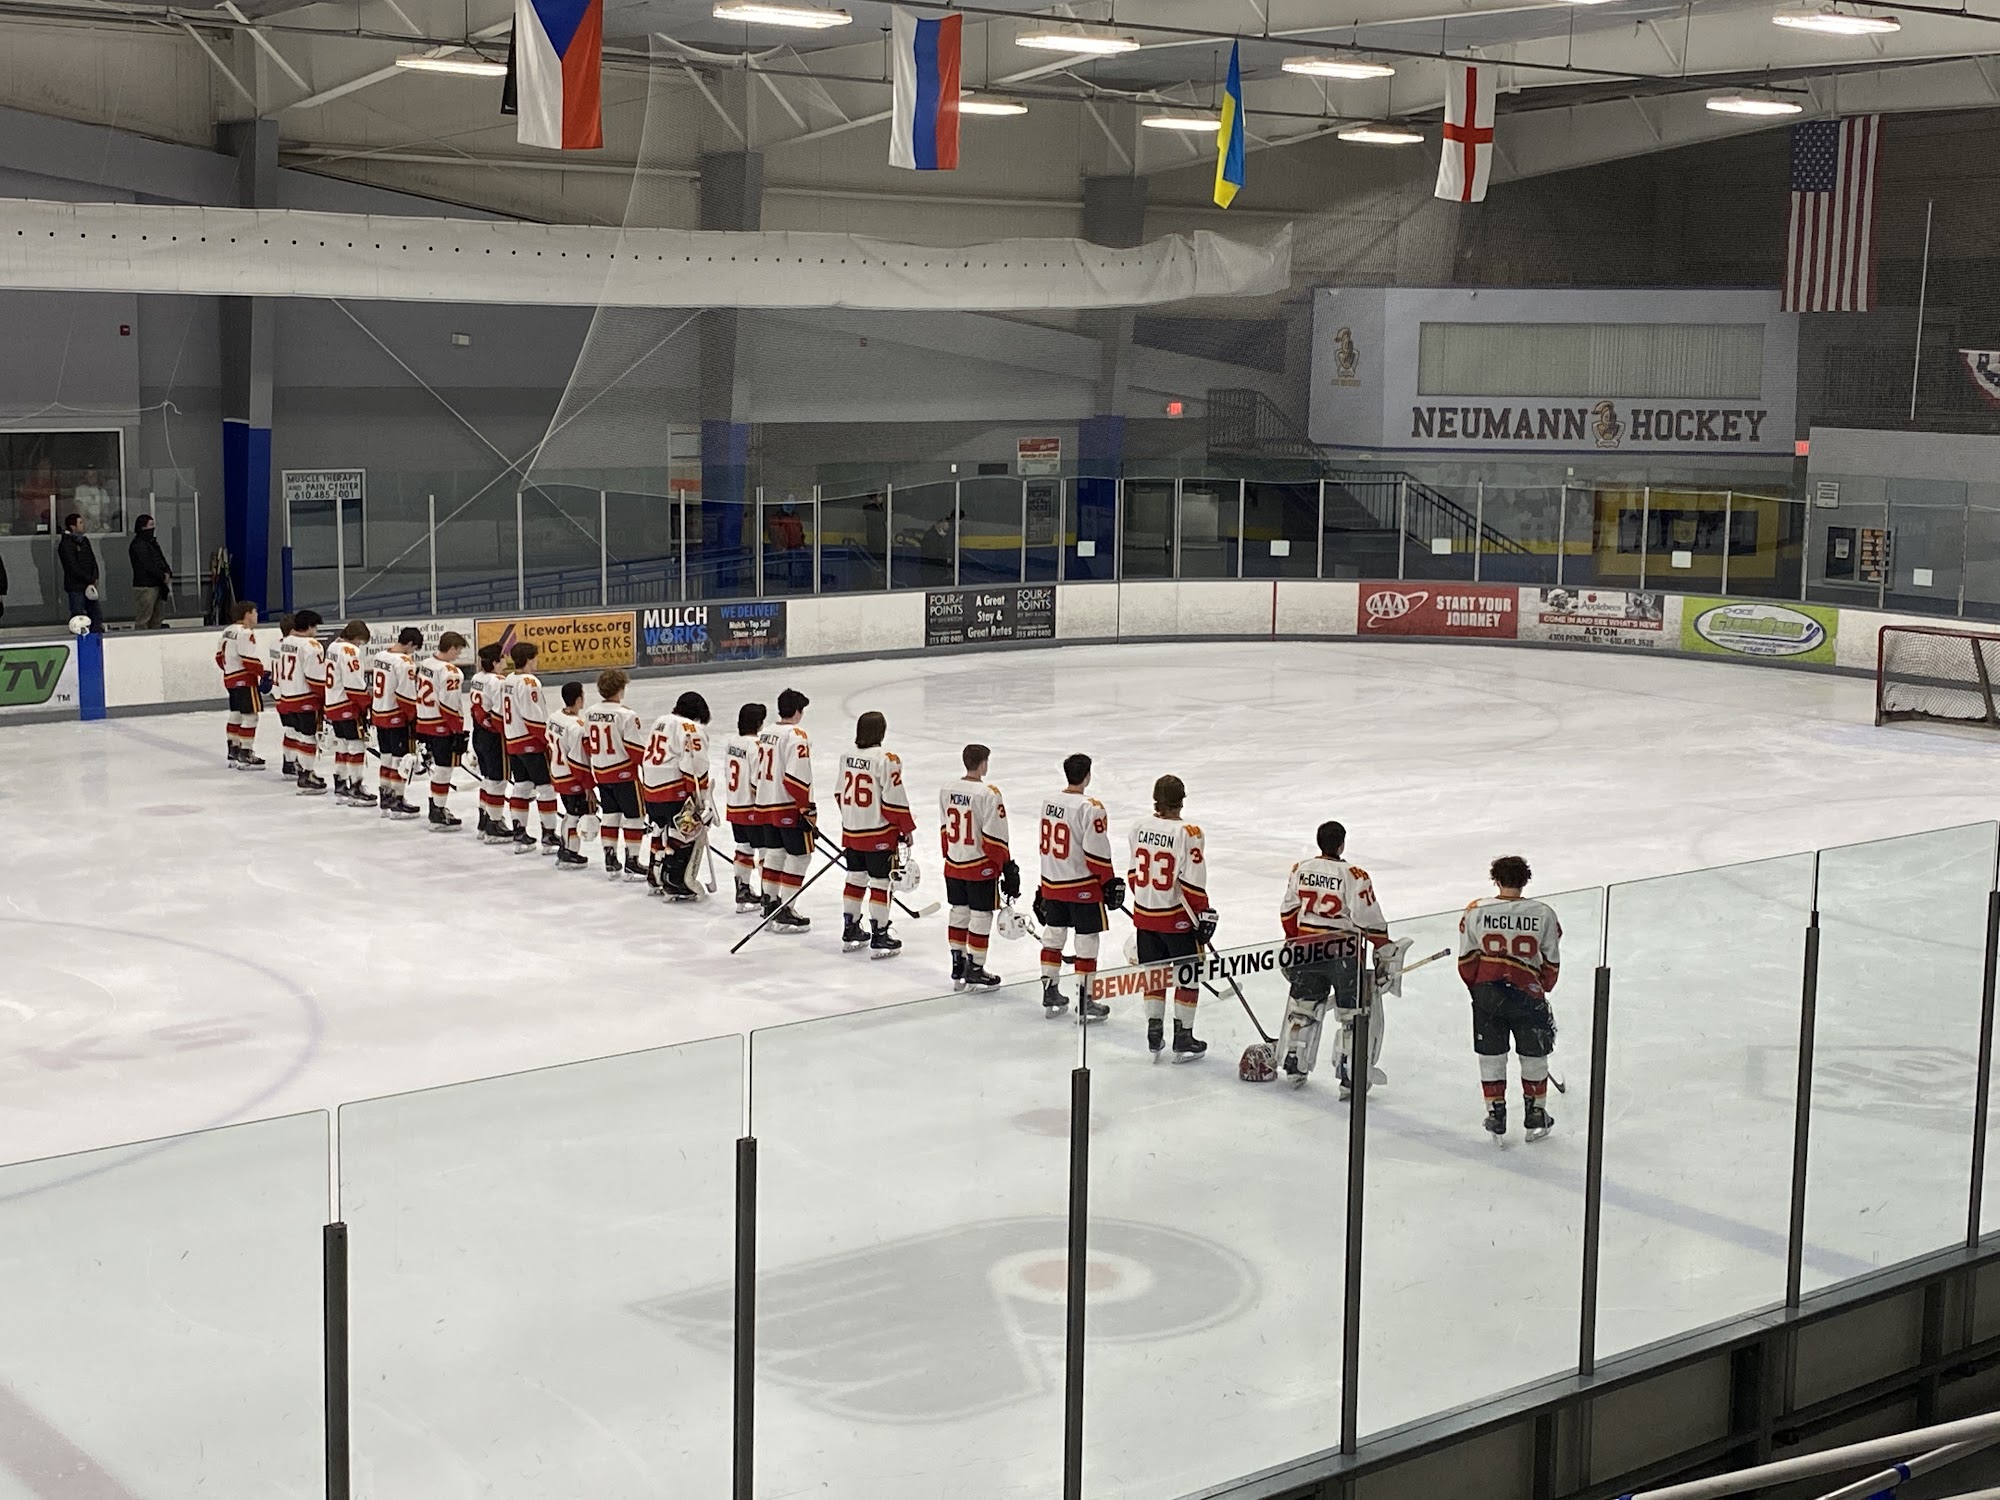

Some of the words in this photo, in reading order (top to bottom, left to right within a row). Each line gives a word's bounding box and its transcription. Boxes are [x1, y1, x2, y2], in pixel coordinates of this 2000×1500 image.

[1411, 407, 1588, 440] NEUMANN
[1630, 409, 1767, 441] HOCKEY
[287, 474, 319, 483] MUSCLE
[323, 473, 358, 482] THERAPY
[930, 594, 956, 605] FOUR
[975, 595, 982, 607] A
[984, 595, 1005, 606] Great
[1017, 589, 1043, 600] FOUR
[720, 605, 737, 619] WE
[737, 603, 779, 618] DELIVER!
[930, 604, 964, 616] POINTS
[1017, 599, 1051, 610] POINTS
[1436, 595, 1476, 611] START
[1478, 597, 1512, 612] YOUR
[643, 605, 708, 629] MULCH
[977, 610, 995, 624] Stay
[996, 609, 1003, 621] &
[1446, 611, 1501, 627] JOURNEY
[1543, 615, 1566, 624] COME
[1567, 616, 1576, 624] IN
[1576, 617, 1594, 625] AND
[1594, 618, 1608, 626] SEE
[431, 622, 445, 632] the
[524, 618, 631, 637] iceworkssc.org
[643, 624, 708, 646] WORKS
[967, 627, 990, 638] Great
[990, 625, 1013, 637] Rates
[1584, 627, 1618, 636] ASTON
[542, 635, 632, 653] ICEWORKS
[602, 651, 629, 659] CLUB
[281, 653, 297, 681] 17
[346, 659, 360, 673] 16
[590, 725, 616, 755] 91
[728, 759, 740, 792] 3
[844, 771, 873, 807] 26
[950, 794, 972, 807] MORAN
[1046, 804, 1065, 819] ORAZI
[946, 807, 975, 846] 31
[1040, 818, 1071, 860] 89
[1138, 830, 1175, 849] CARSON
[1135, 847, 1175, 892] 33
[1299, 873, 1343, 891] McGARVEY
[1298, 889, 1343, 919] 72
[1483, 914, 1540, 931] McGLADE
[1092, 966, 1174, 1001] BEWARE
[1178, 962, 1205, 985] OF
[1209, 950, 1274, 981] FLYING
[1279, 935, 1356, 968] OBJECTS
